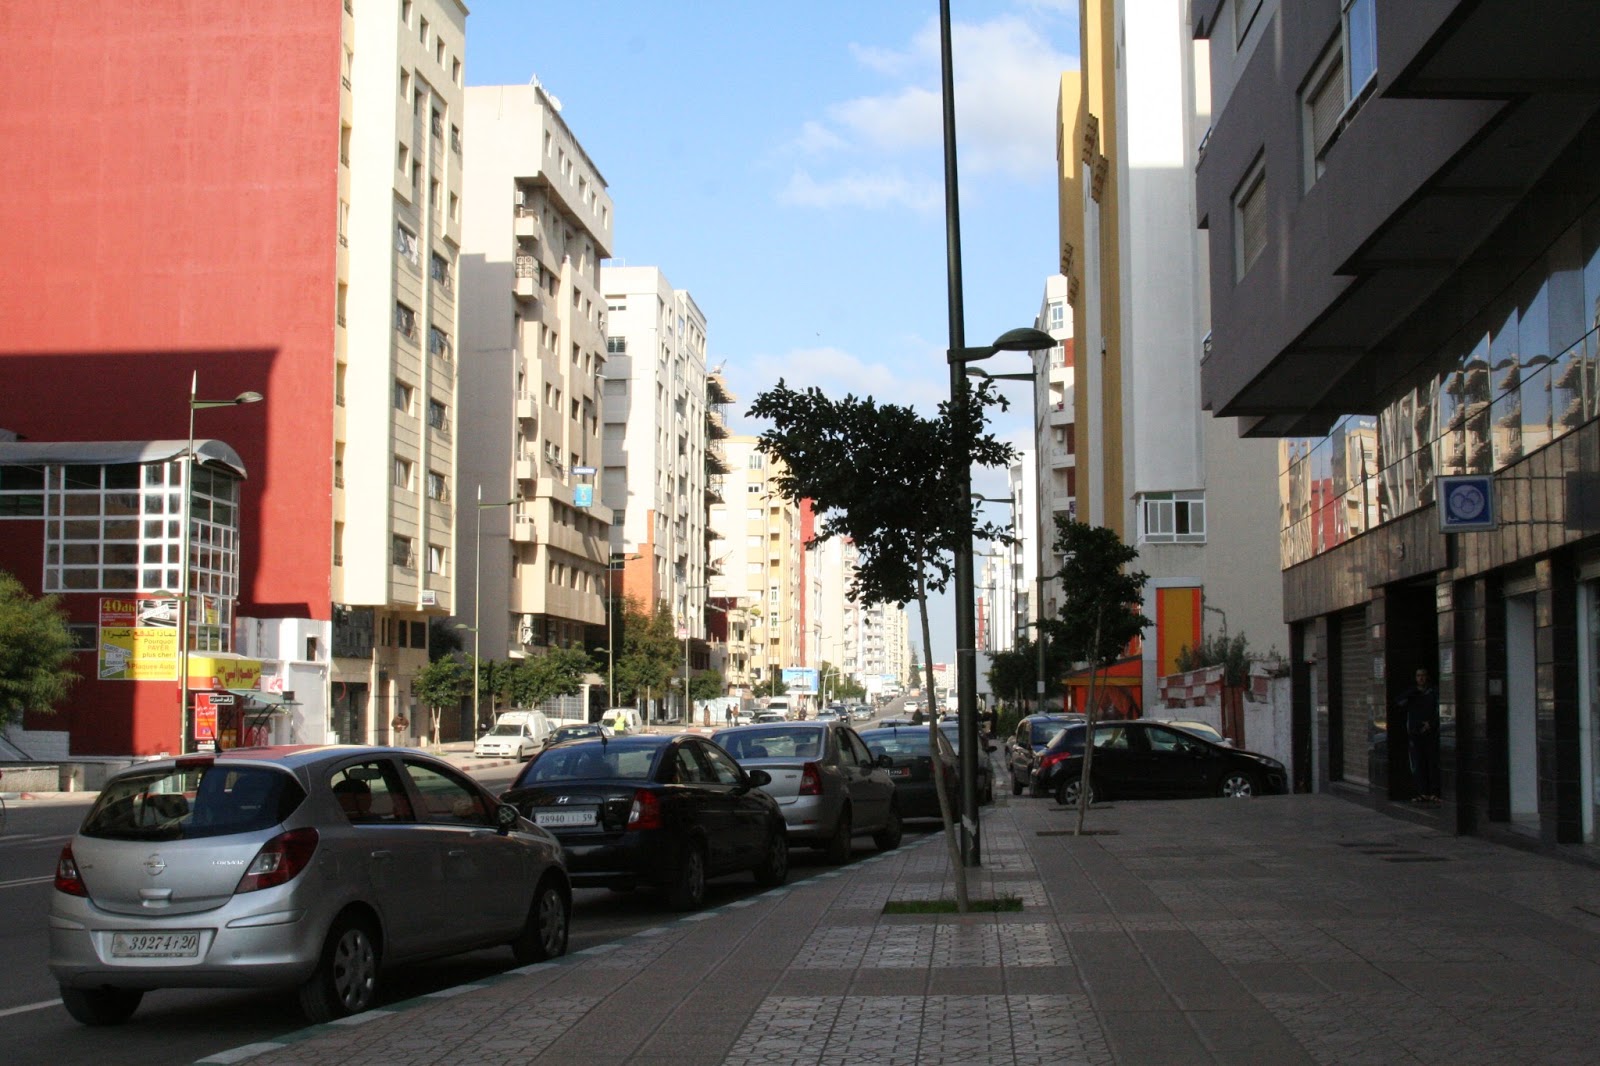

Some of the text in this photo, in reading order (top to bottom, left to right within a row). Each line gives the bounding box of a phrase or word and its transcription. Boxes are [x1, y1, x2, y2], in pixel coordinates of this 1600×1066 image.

[103, 600, 135, 612] 40dh
[143, 638, 174, 646] Pourquoi
[540, 814, 565, 824] 28940
[582, 813, 593, 822] 59
